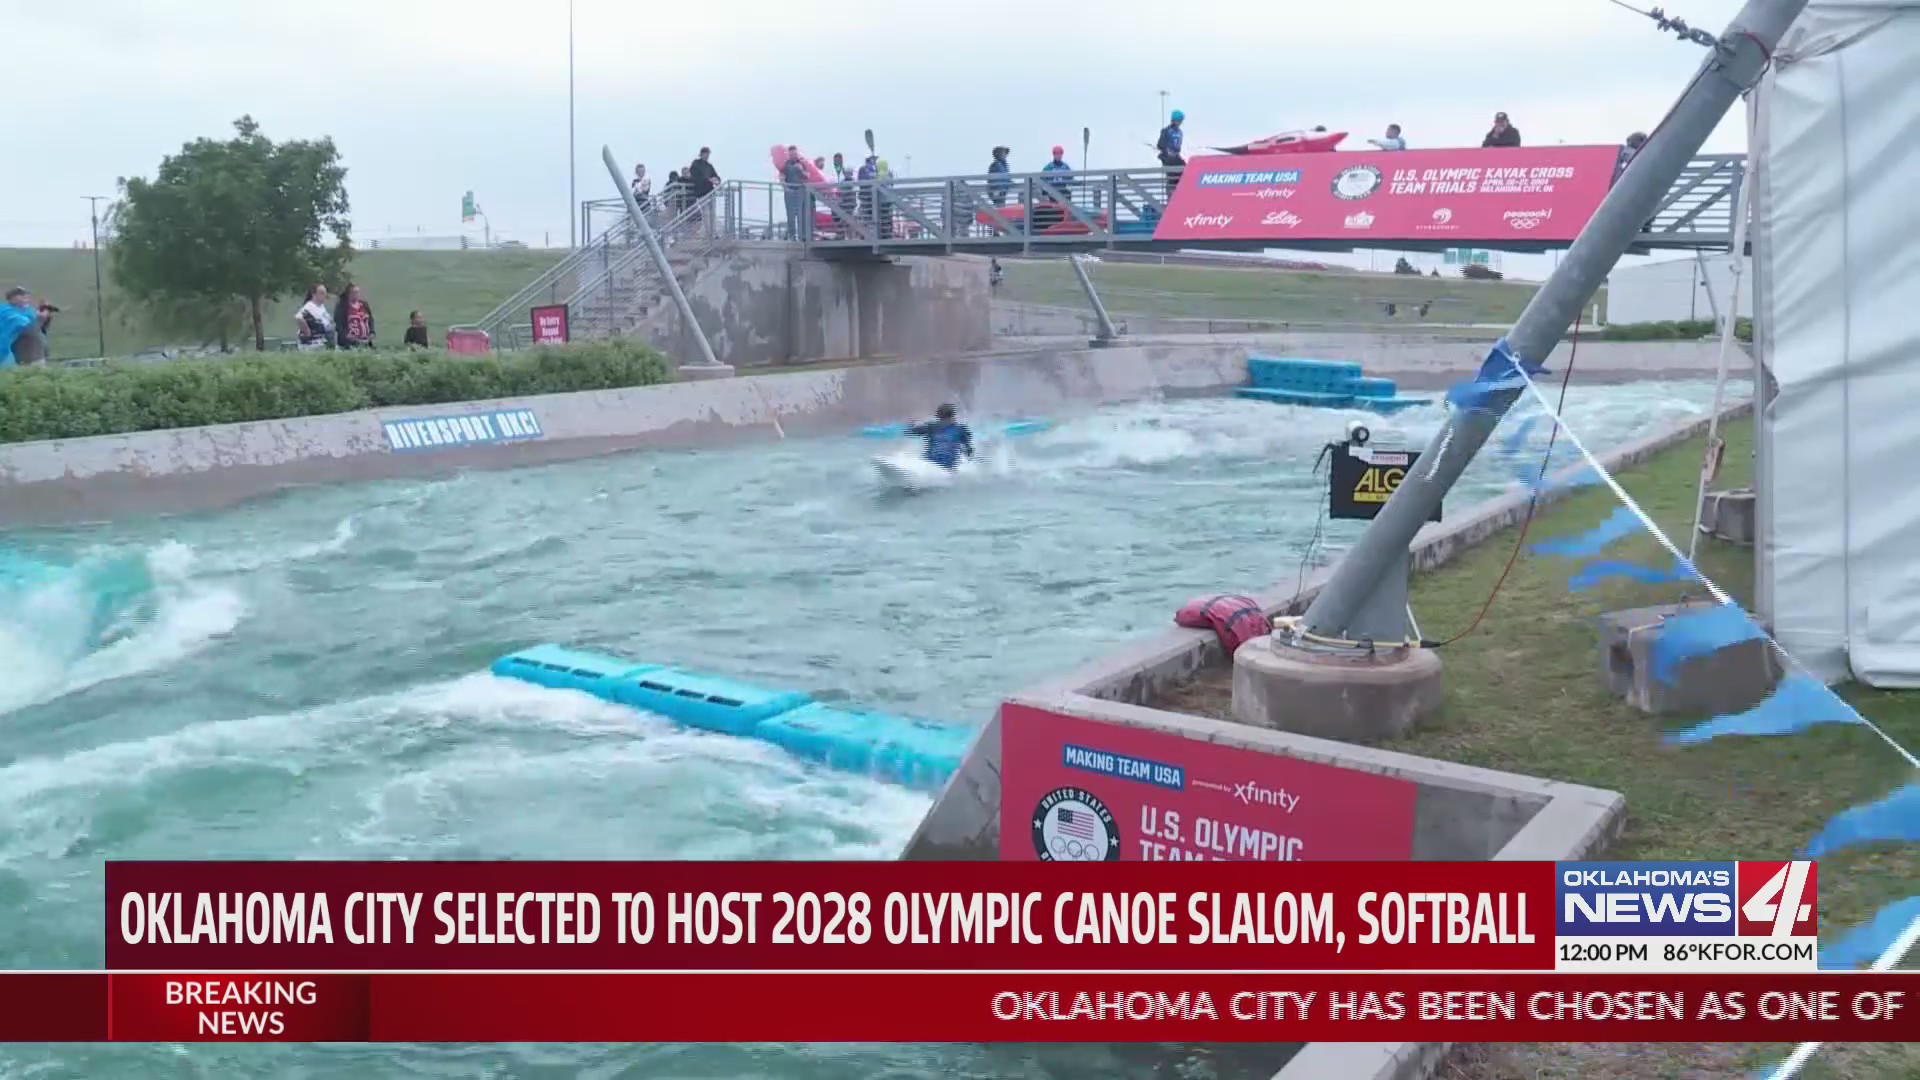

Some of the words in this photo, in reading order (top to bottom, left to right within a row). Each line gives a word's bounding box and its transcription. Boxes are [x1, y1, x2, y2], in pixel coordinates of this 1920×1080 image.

[1201, 173, 1242, 184] MAKING
[1244, 172, 1273, 183] TEAM
[1275, 171, 1298, 182] USA
[1393, 169, 1417, 181] U.S.
[1422, 168, 1481, 181] OLYMPIC
[1485, 167, 1528, 179] KAYAK
[1530, 166, 1574, 179] CROSS
[1256, 188, 1295, 199] xfinity
[1389, 182, 1424, 194] TEAM
[1429, 181, 1476, 193] TRIALS
[1183, 213, 1233, 228] xfinity
[385, 415, 496, 449] RIVERSPORT
[496, 411, 541, 437] OKC!
[1066, 746, 1114, 772] MAKING
[1117, 757, 1151, 780] TEAM
[1154, 767, 1181, 786] USA
[1041, 788, 1075, 809] UNITED
[1078, 791, 1112, 823] STATES
[1234, 781, 1300, 813] xfinity
[1141, 804, 1185, 843] U.S.
[1195, 817, 1304, 861] OLYMPIC
